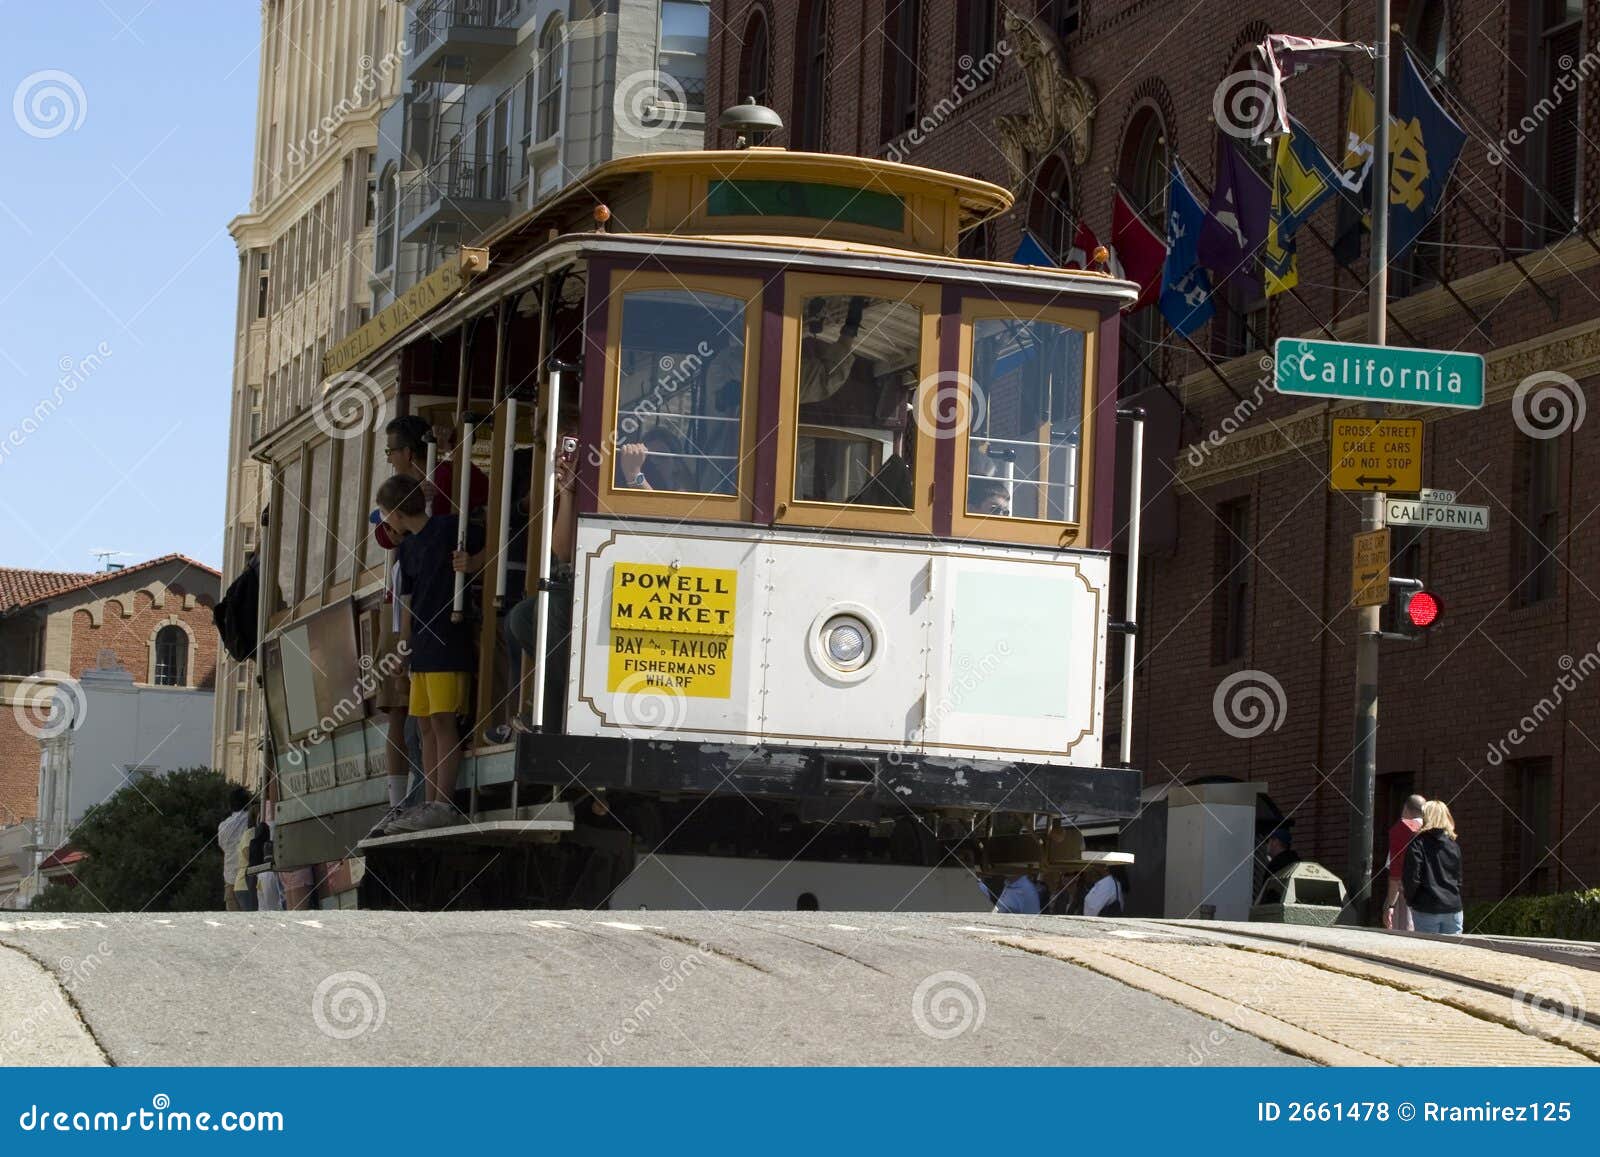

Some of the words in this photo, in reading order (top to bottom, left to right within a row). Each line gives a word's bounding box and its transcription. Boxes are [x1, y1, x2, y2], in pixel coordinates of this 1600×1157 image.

[1299, 352, 1462, 393] California
[1338, 425, 1372, 437] CROSS
[1379, 426, 1417, 438] STREET
[1343, 441, 1376, 453] CABLE
[1384, 442, 1411, 454] CARS
[1340, 457, 1355, 468] DO
[1361, 457, 1381, 469] NOT
[1386, 458, 1412, 470] STOP
[1391, 505, 1484, 526] CALIFORNIA
[620, 572, 729, 594] POWELL
[648, 591, 703, 606] AND
[617, 603, 730, 625] MARKET
[615, 635, 644, 655] BAY
[649, 638, 666, 656] AND
[671, 639, 728, 660] TAYLOR
[624, 659, 716, 676] FISHERMANS
[646, 674, 693, 688] WHARF
